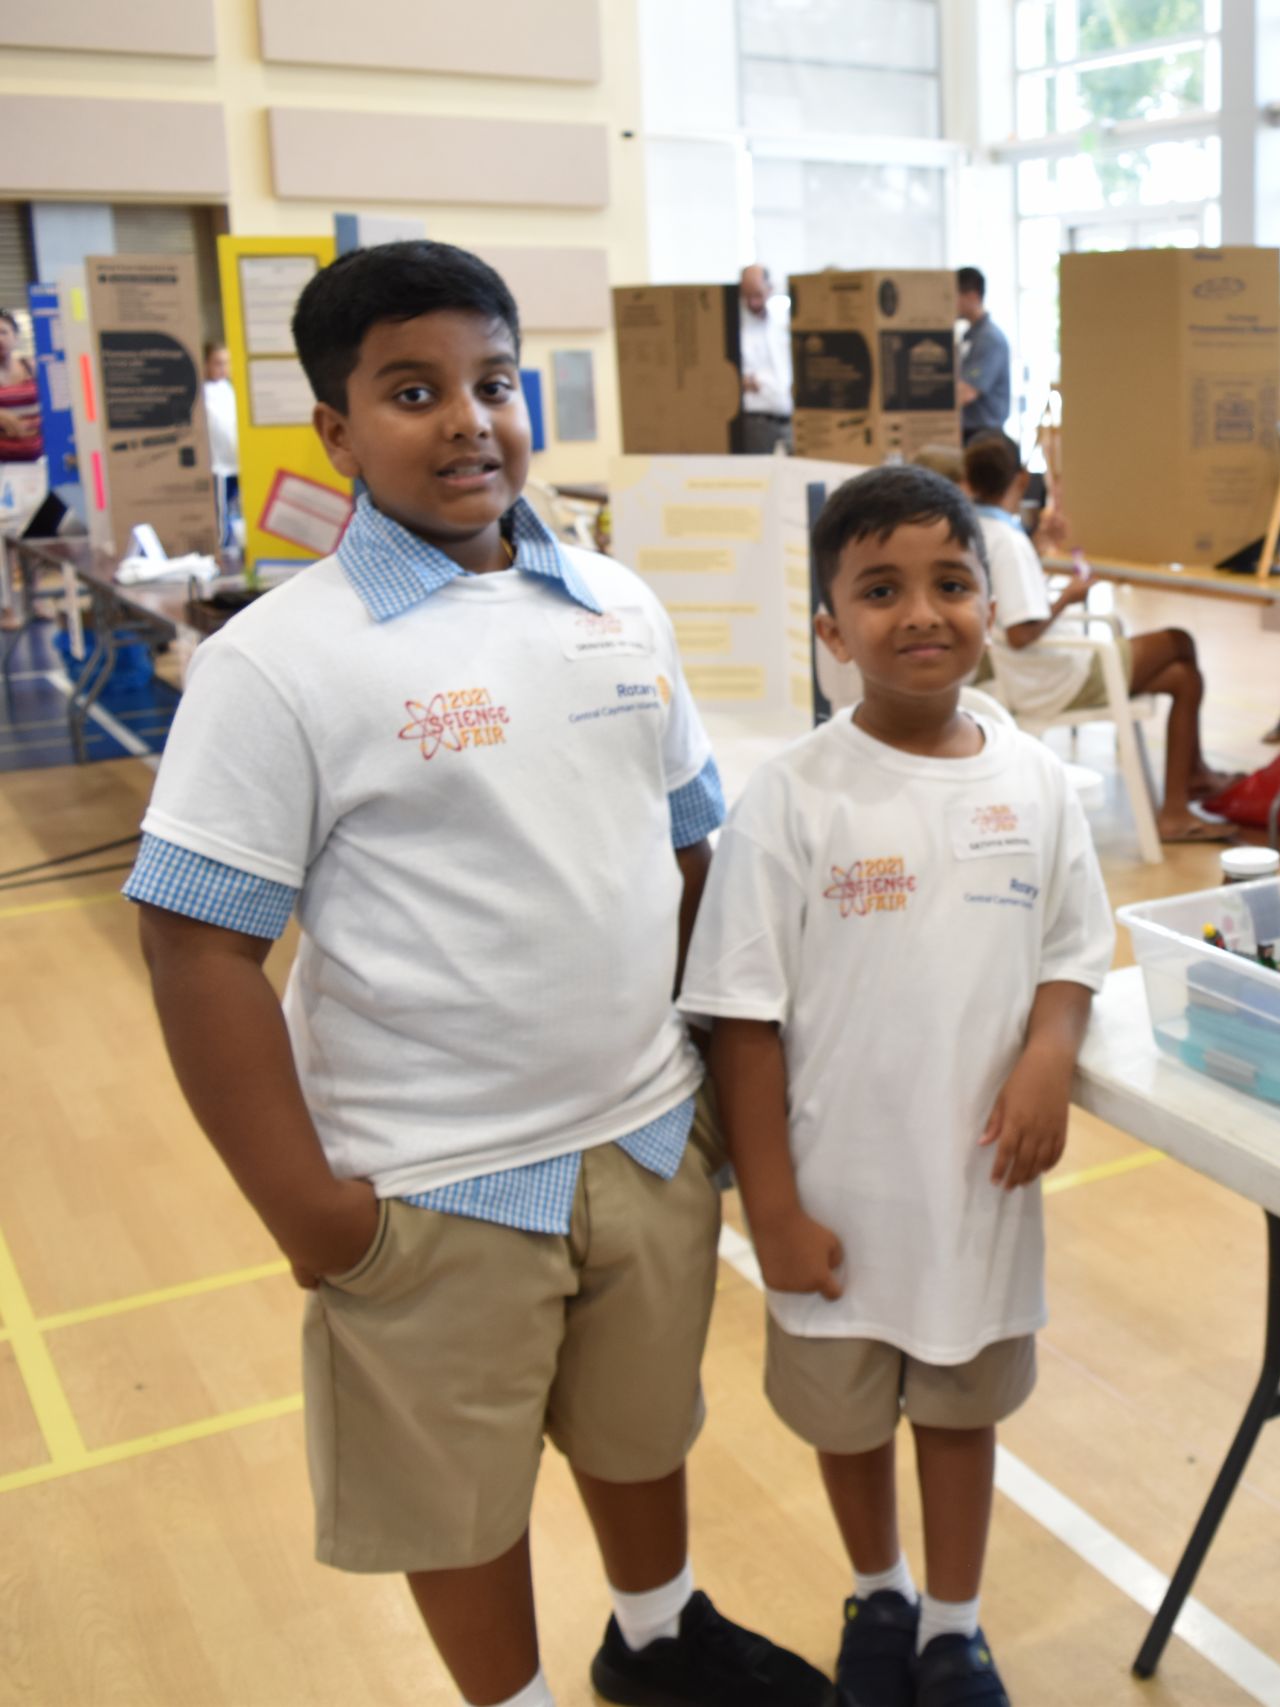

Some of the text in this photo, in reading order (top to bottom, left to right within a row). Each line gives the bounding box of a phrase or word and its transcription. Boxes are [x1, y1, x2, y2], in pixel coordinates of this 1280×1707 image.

[429, 706, 511, 734] SCIENCE
[460, 727, 507, 747] FAIR
[849, 876, 917, 897] SCIENCE
